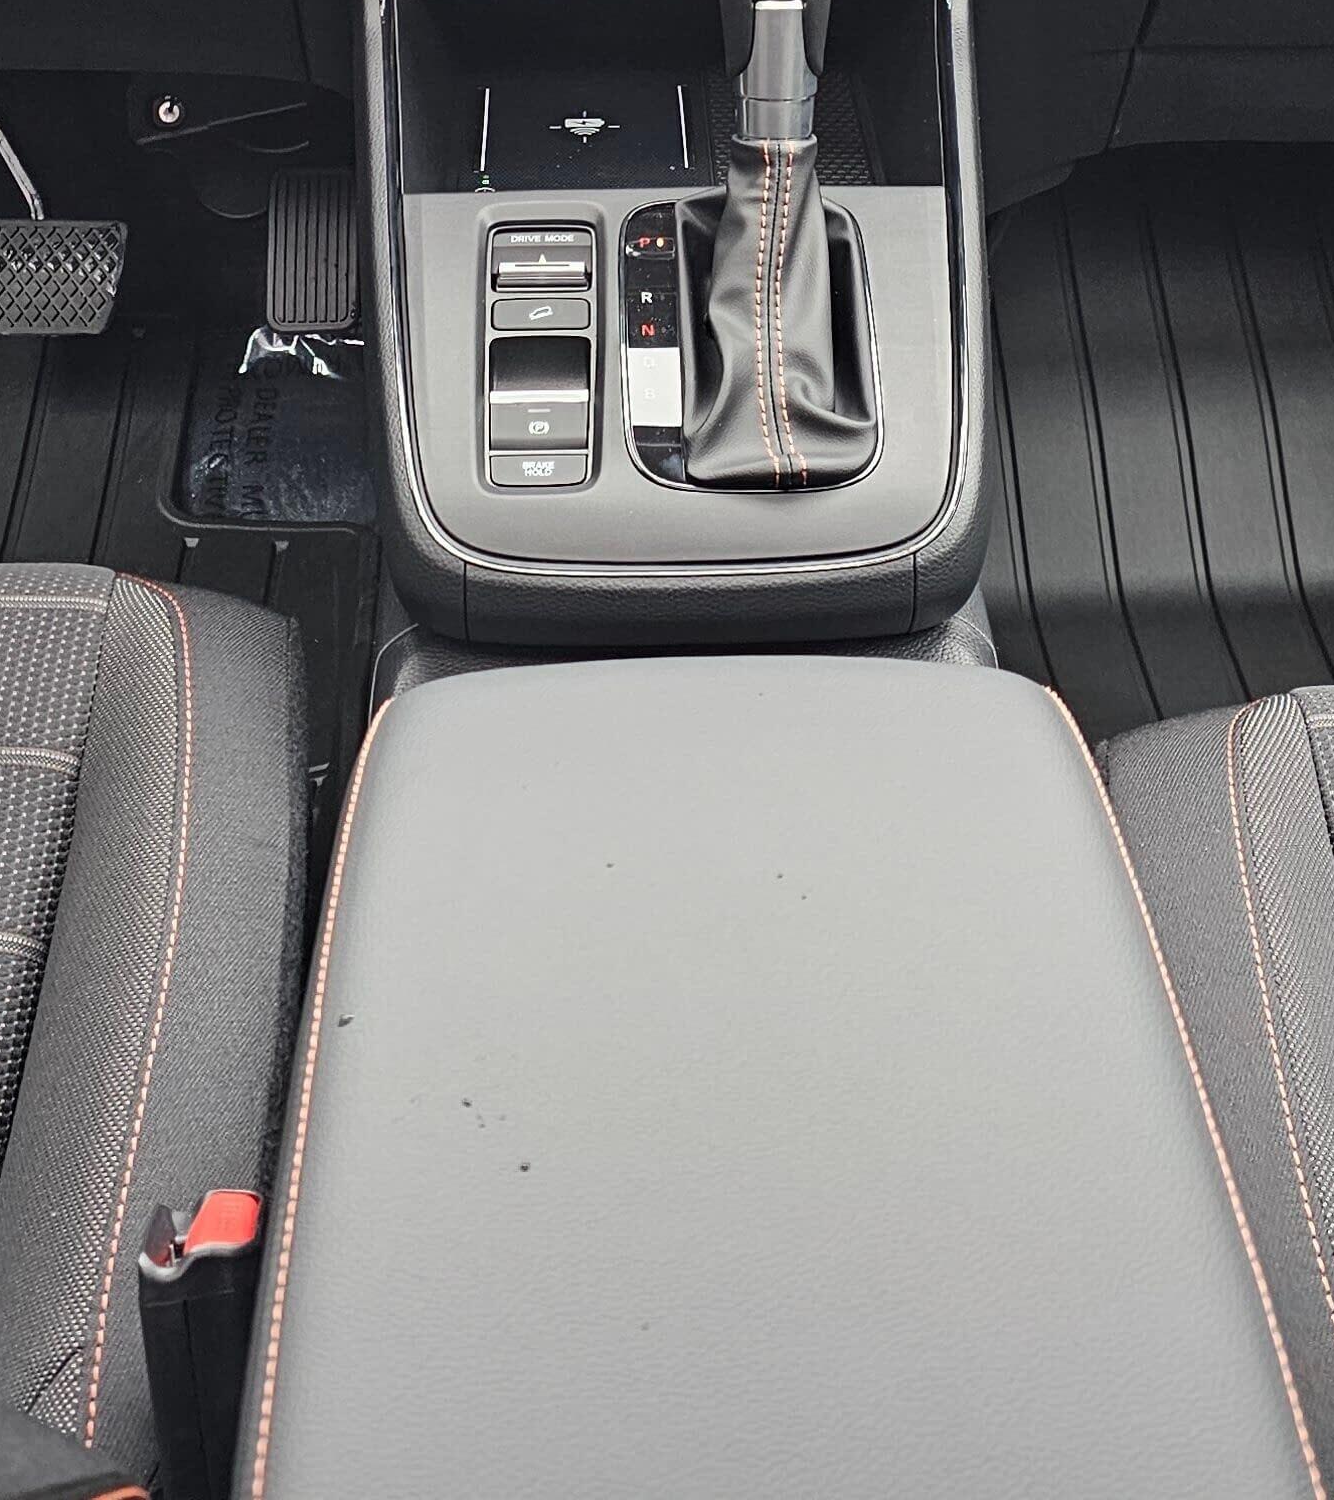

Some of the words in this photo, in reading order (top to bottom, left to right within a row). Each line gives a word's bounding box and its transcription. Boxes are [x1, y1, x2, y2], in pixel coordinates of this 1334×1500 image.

[510, 234, 541, 243] DRIVE
[544, 234, 575, 243] MODE
[638, 237, 650, 248] P
[641, 291, 653, 304] R
[641, 324, 655, 337] N
[522, 461, 555, 470] BRAKE
[524, 468, 553, 477] HOLD
